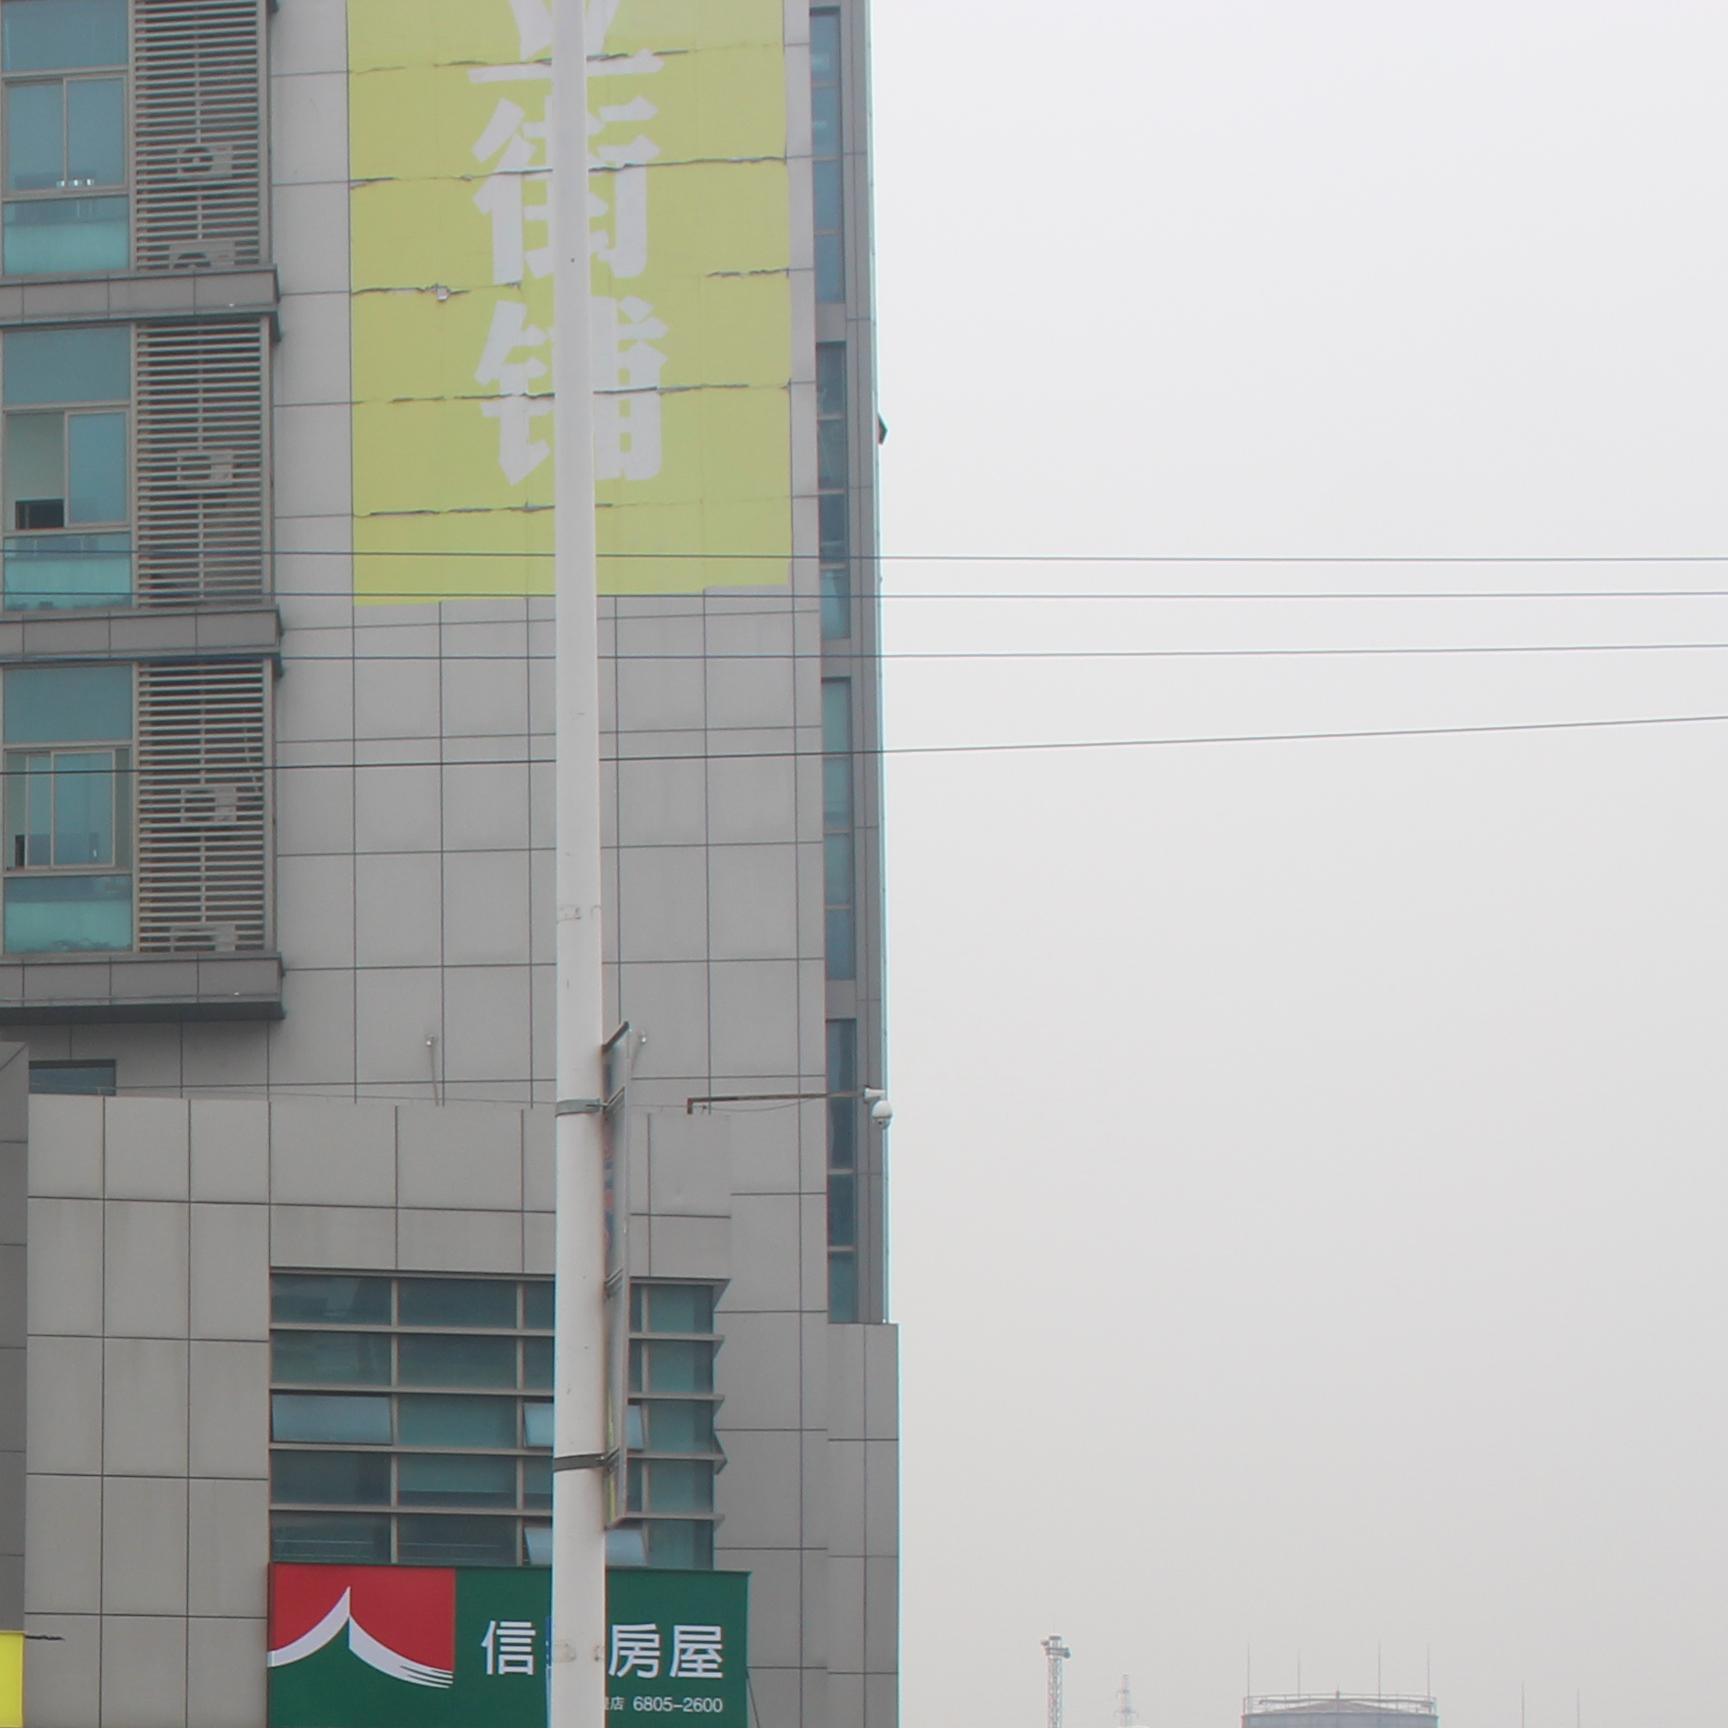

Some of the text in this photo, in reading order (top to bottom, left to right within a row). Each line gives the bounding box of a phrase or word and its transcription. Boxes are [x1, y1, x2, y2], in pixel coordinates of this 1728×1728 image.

[481, 1620, 724, 1680] 信房屋
[632, 1697, 724, 1713] 6805-2600
